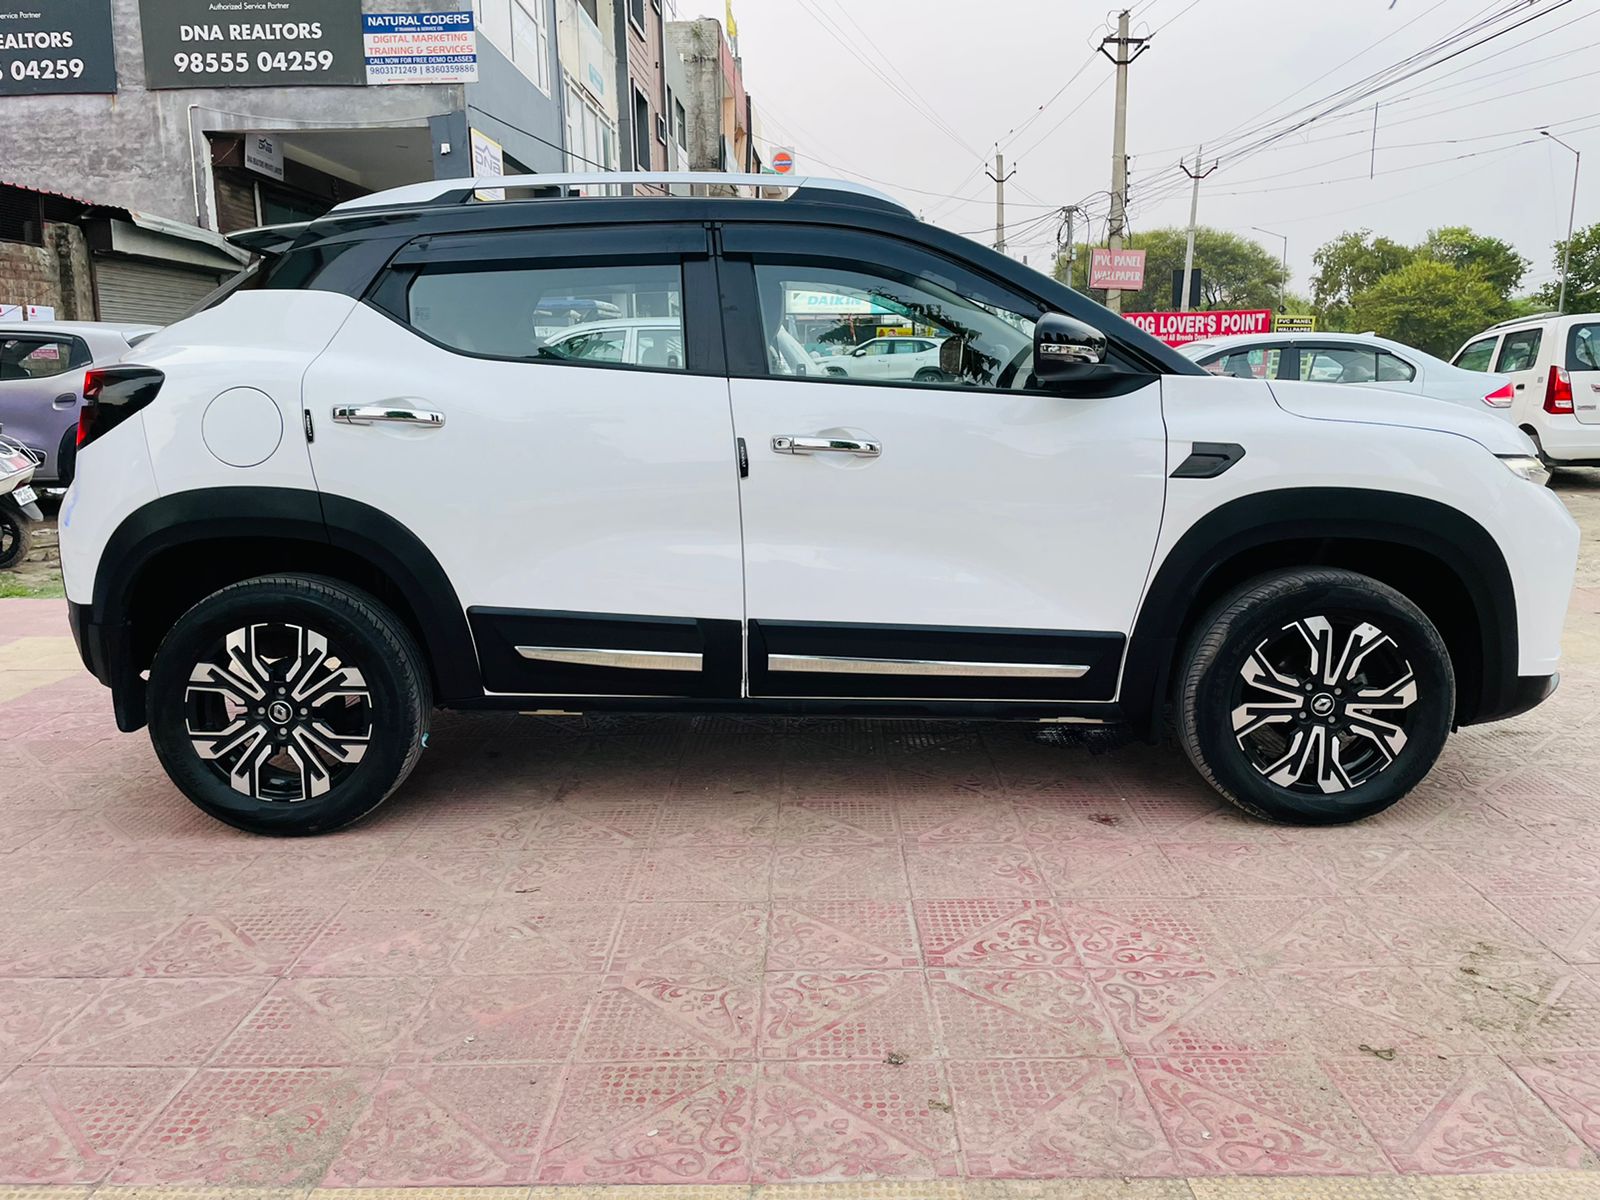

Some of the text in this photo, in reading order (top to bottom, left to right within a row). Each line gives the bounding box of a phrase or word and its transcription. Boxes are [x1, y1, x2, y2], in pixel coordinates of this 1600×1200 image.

[208, 3, 243, 11] Authorized
[244, 2, 266, 10] Service
[0, 11, 41, 19] ervice Partner
[368, 14, 470, 26] NATURAL CODERS
[180, 22, 322, 41] DNA REALTORS
[0, 31, 73, 49] EALTORS
[373, 33, 468, 43] DIGITAL MARKETING
[369, 46, 414, 55] TRAINING
[426, 45, 474, 54] SERVICES
[174, 50, 334, 73] 98555 04259
[10, 58, 84, 81] 04259
[370, 64, 475, 74] 9803171249 8360359886
[1095, 255, 1141, 267] PVC PANEL
[1094, 271, 1141, 281] WALLPAPER
[1159, 314, 1217, 333] LOVER'S
[1221, 313, 1266, 332] POINT
